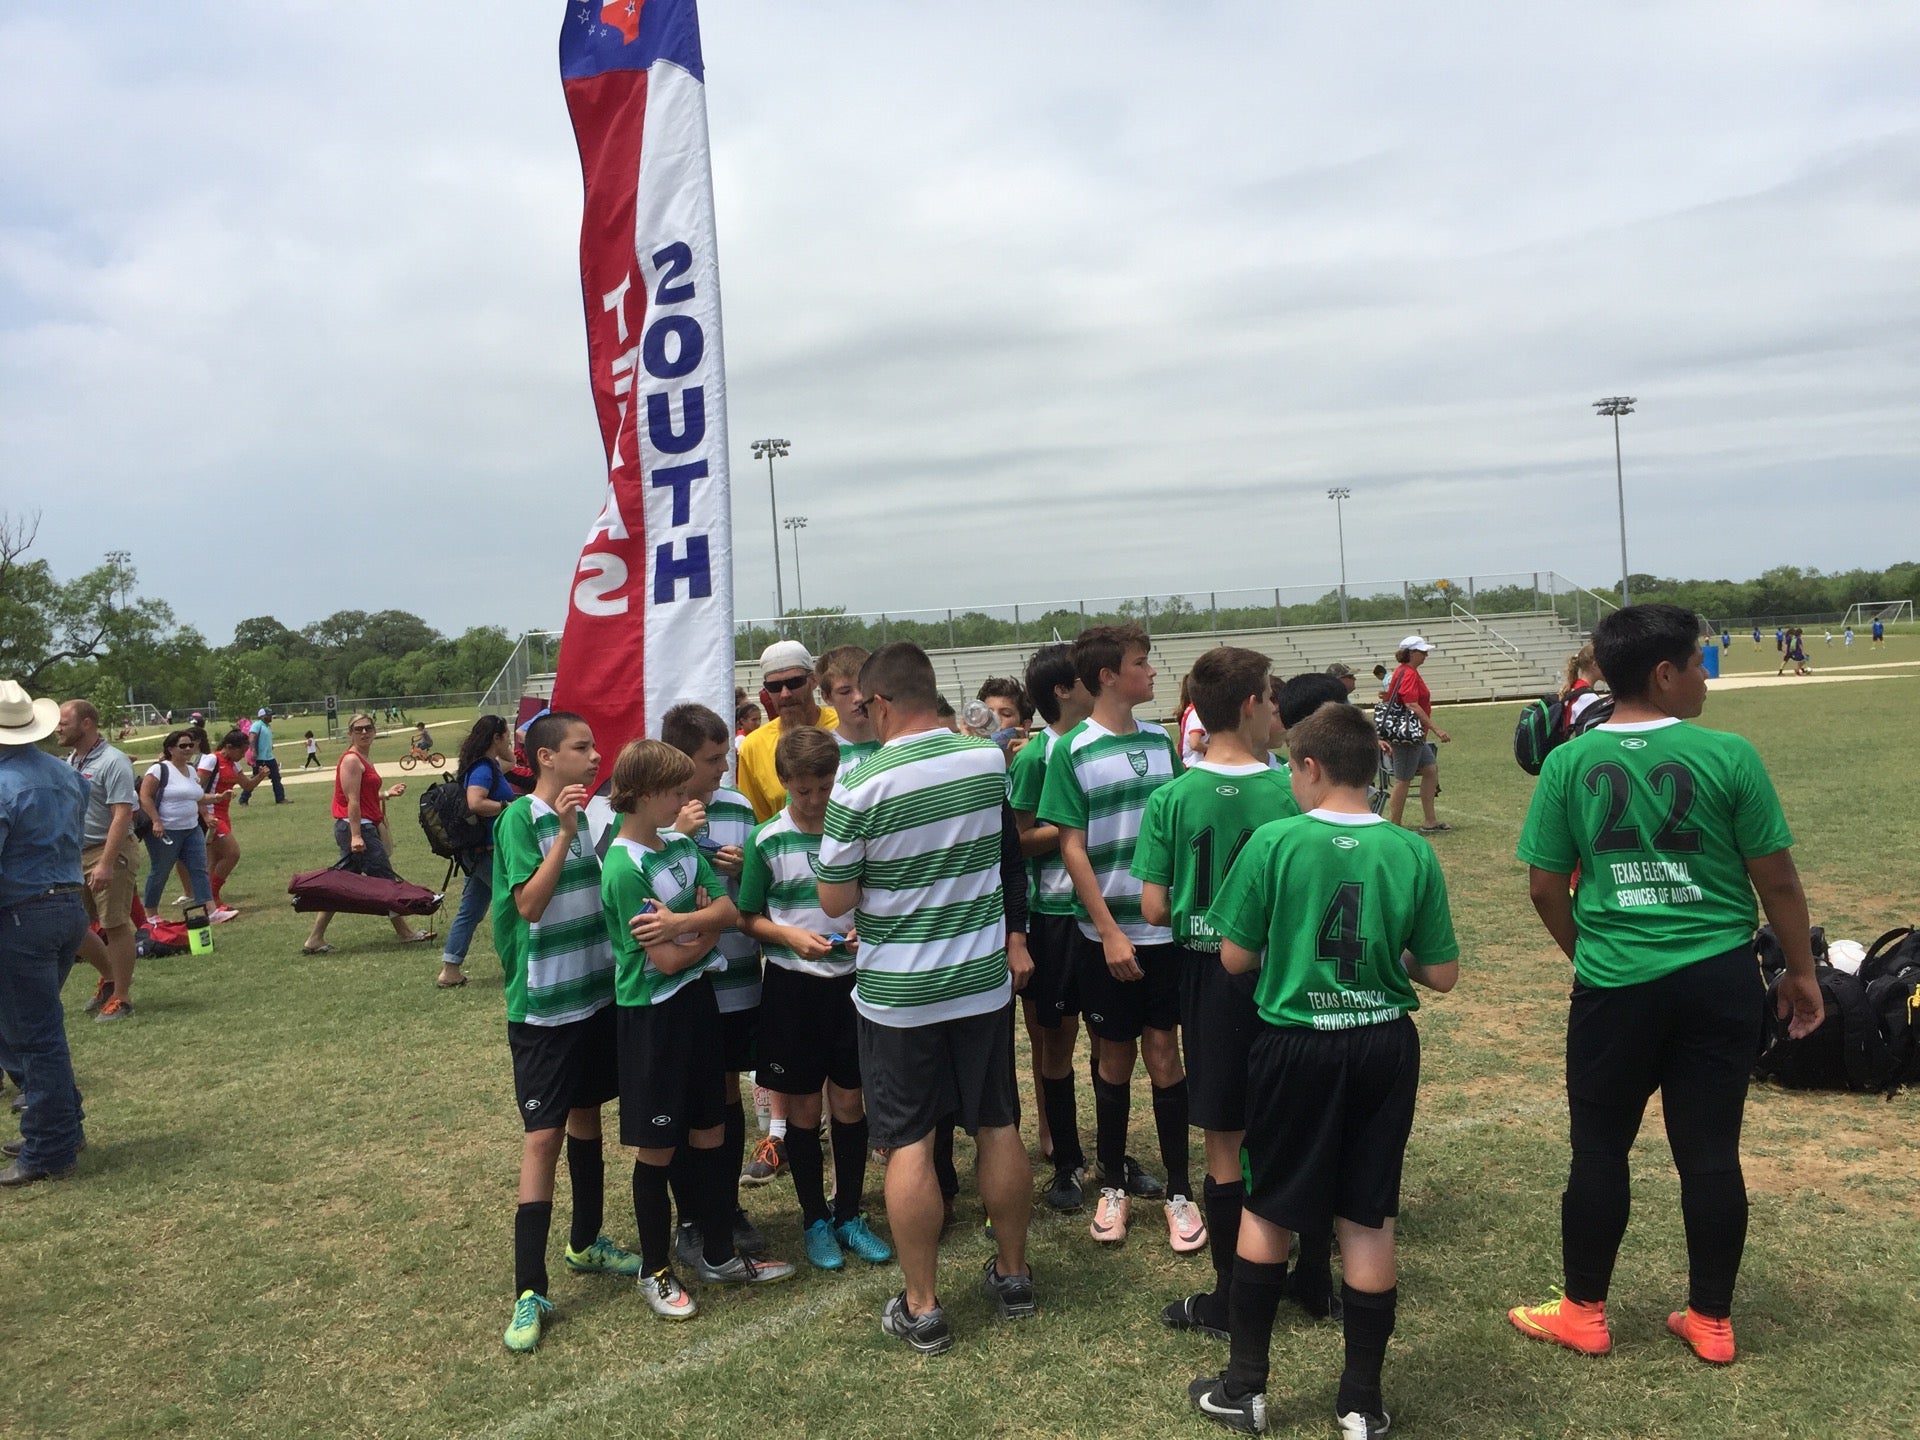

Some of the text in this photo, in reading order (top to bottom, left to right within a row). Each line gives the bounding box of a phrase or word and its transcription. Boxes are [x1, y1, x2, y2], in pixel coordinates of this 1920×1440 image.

[1582, 760, 1705, 856] 22
[1610, 862, 1642, 885] TEXAS
[1616, 885, 1703, 908] SERVICES OF AUSTIN
[1315, 880, 1368, 985] 4
[1307, 990, 1389, 1010] TEXAS ELECRICAL
[1312, 1012, 1356, 1031] SERVICES
[1358, 1011, 1370, 1027] OF
